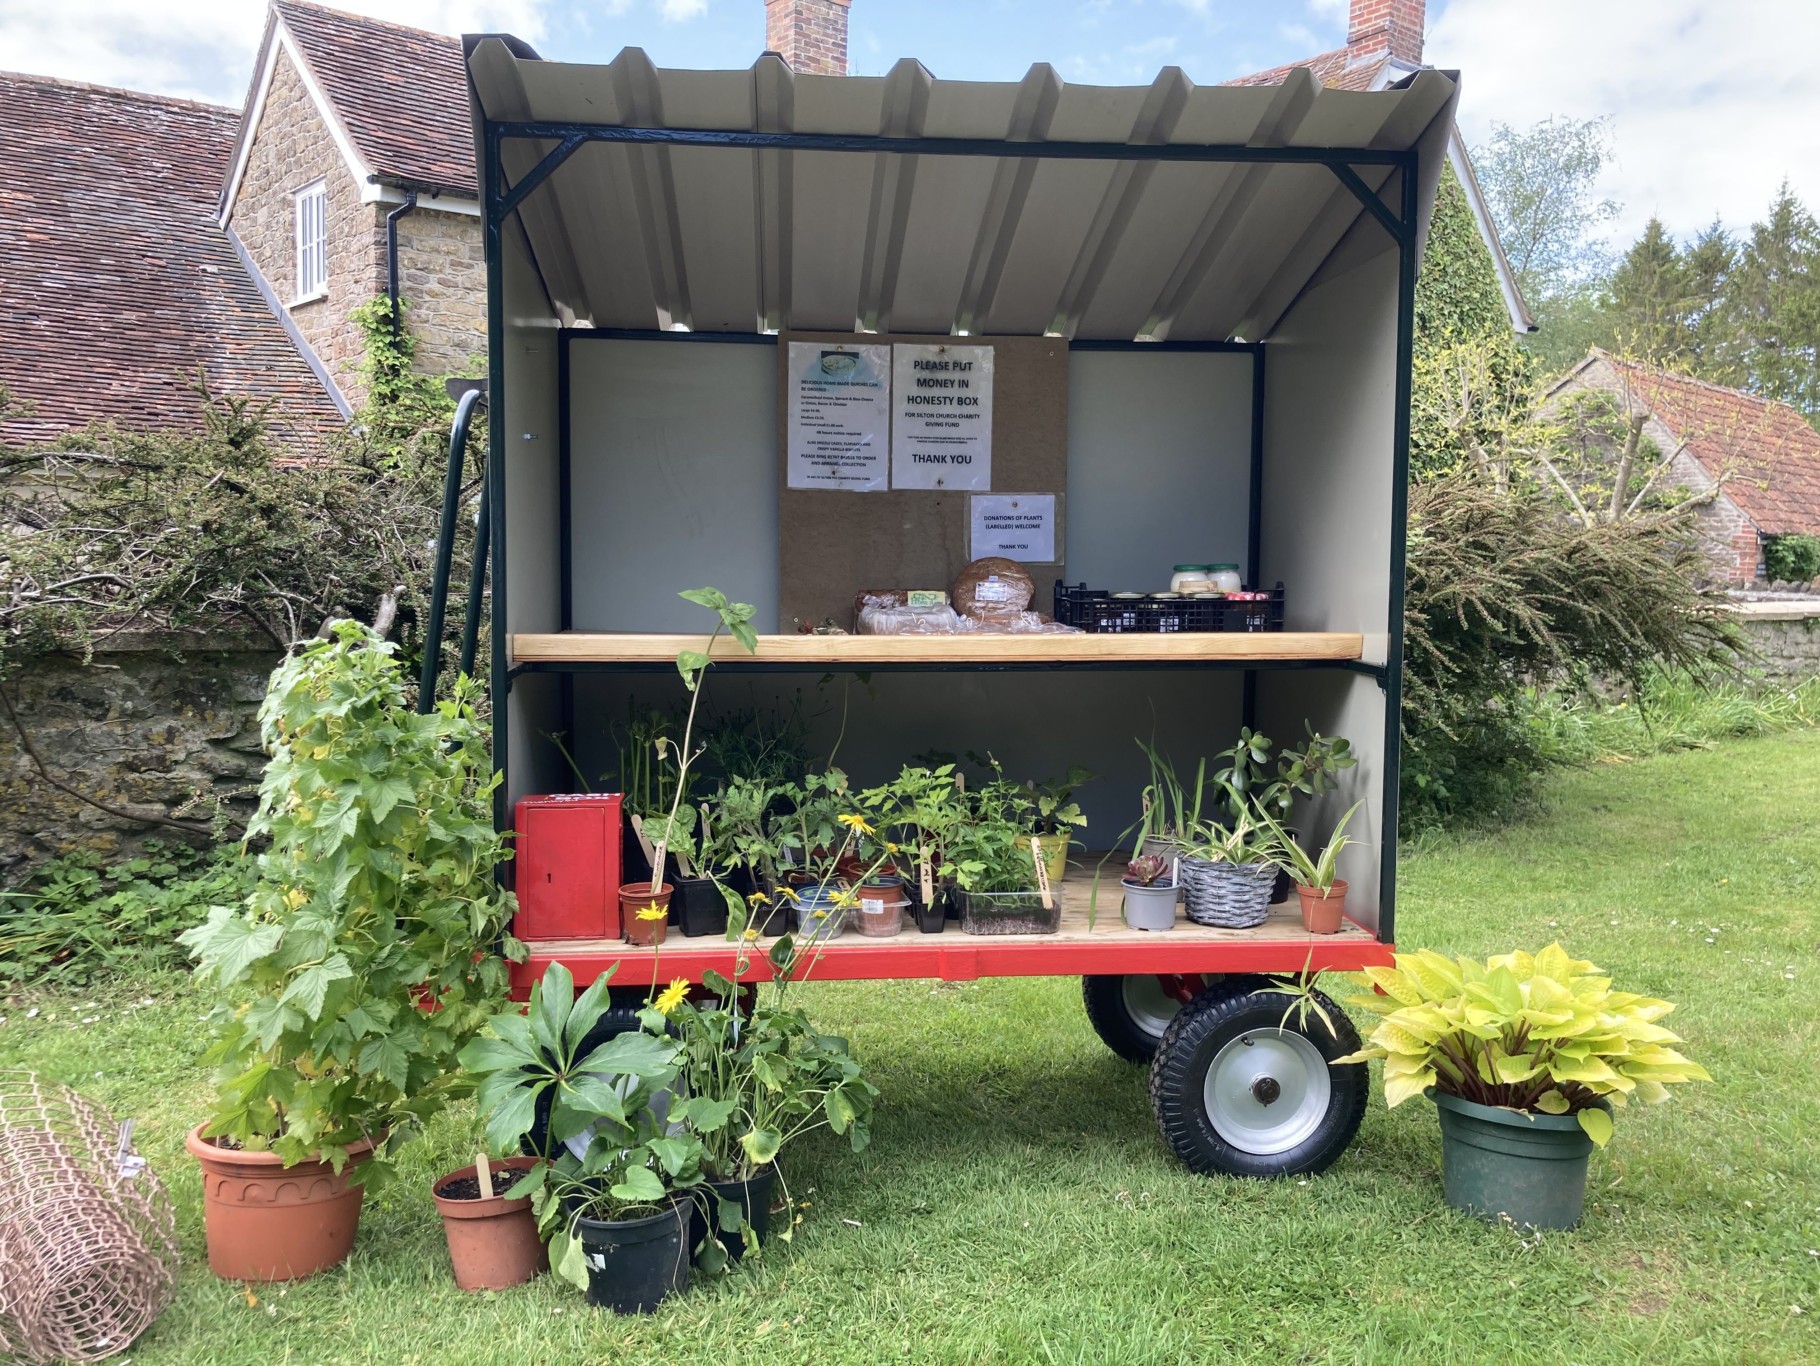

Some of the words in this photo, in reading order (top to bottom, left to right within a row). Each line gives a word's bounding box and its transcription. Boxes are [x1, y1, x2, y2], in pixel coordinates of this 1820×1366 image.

[914, 360, 950, 371] PLEASE
[953, 361, 973, 371] PUT
[917, 378, 955, 388] MONEY
[958, 379, 969, 388] IN
[907, 395, 954, 406] HONESTY
[957, 396, 978, 406] BOX
[912, 454, 947, 464] THANK
[950, 455, 972, 464] YOU
